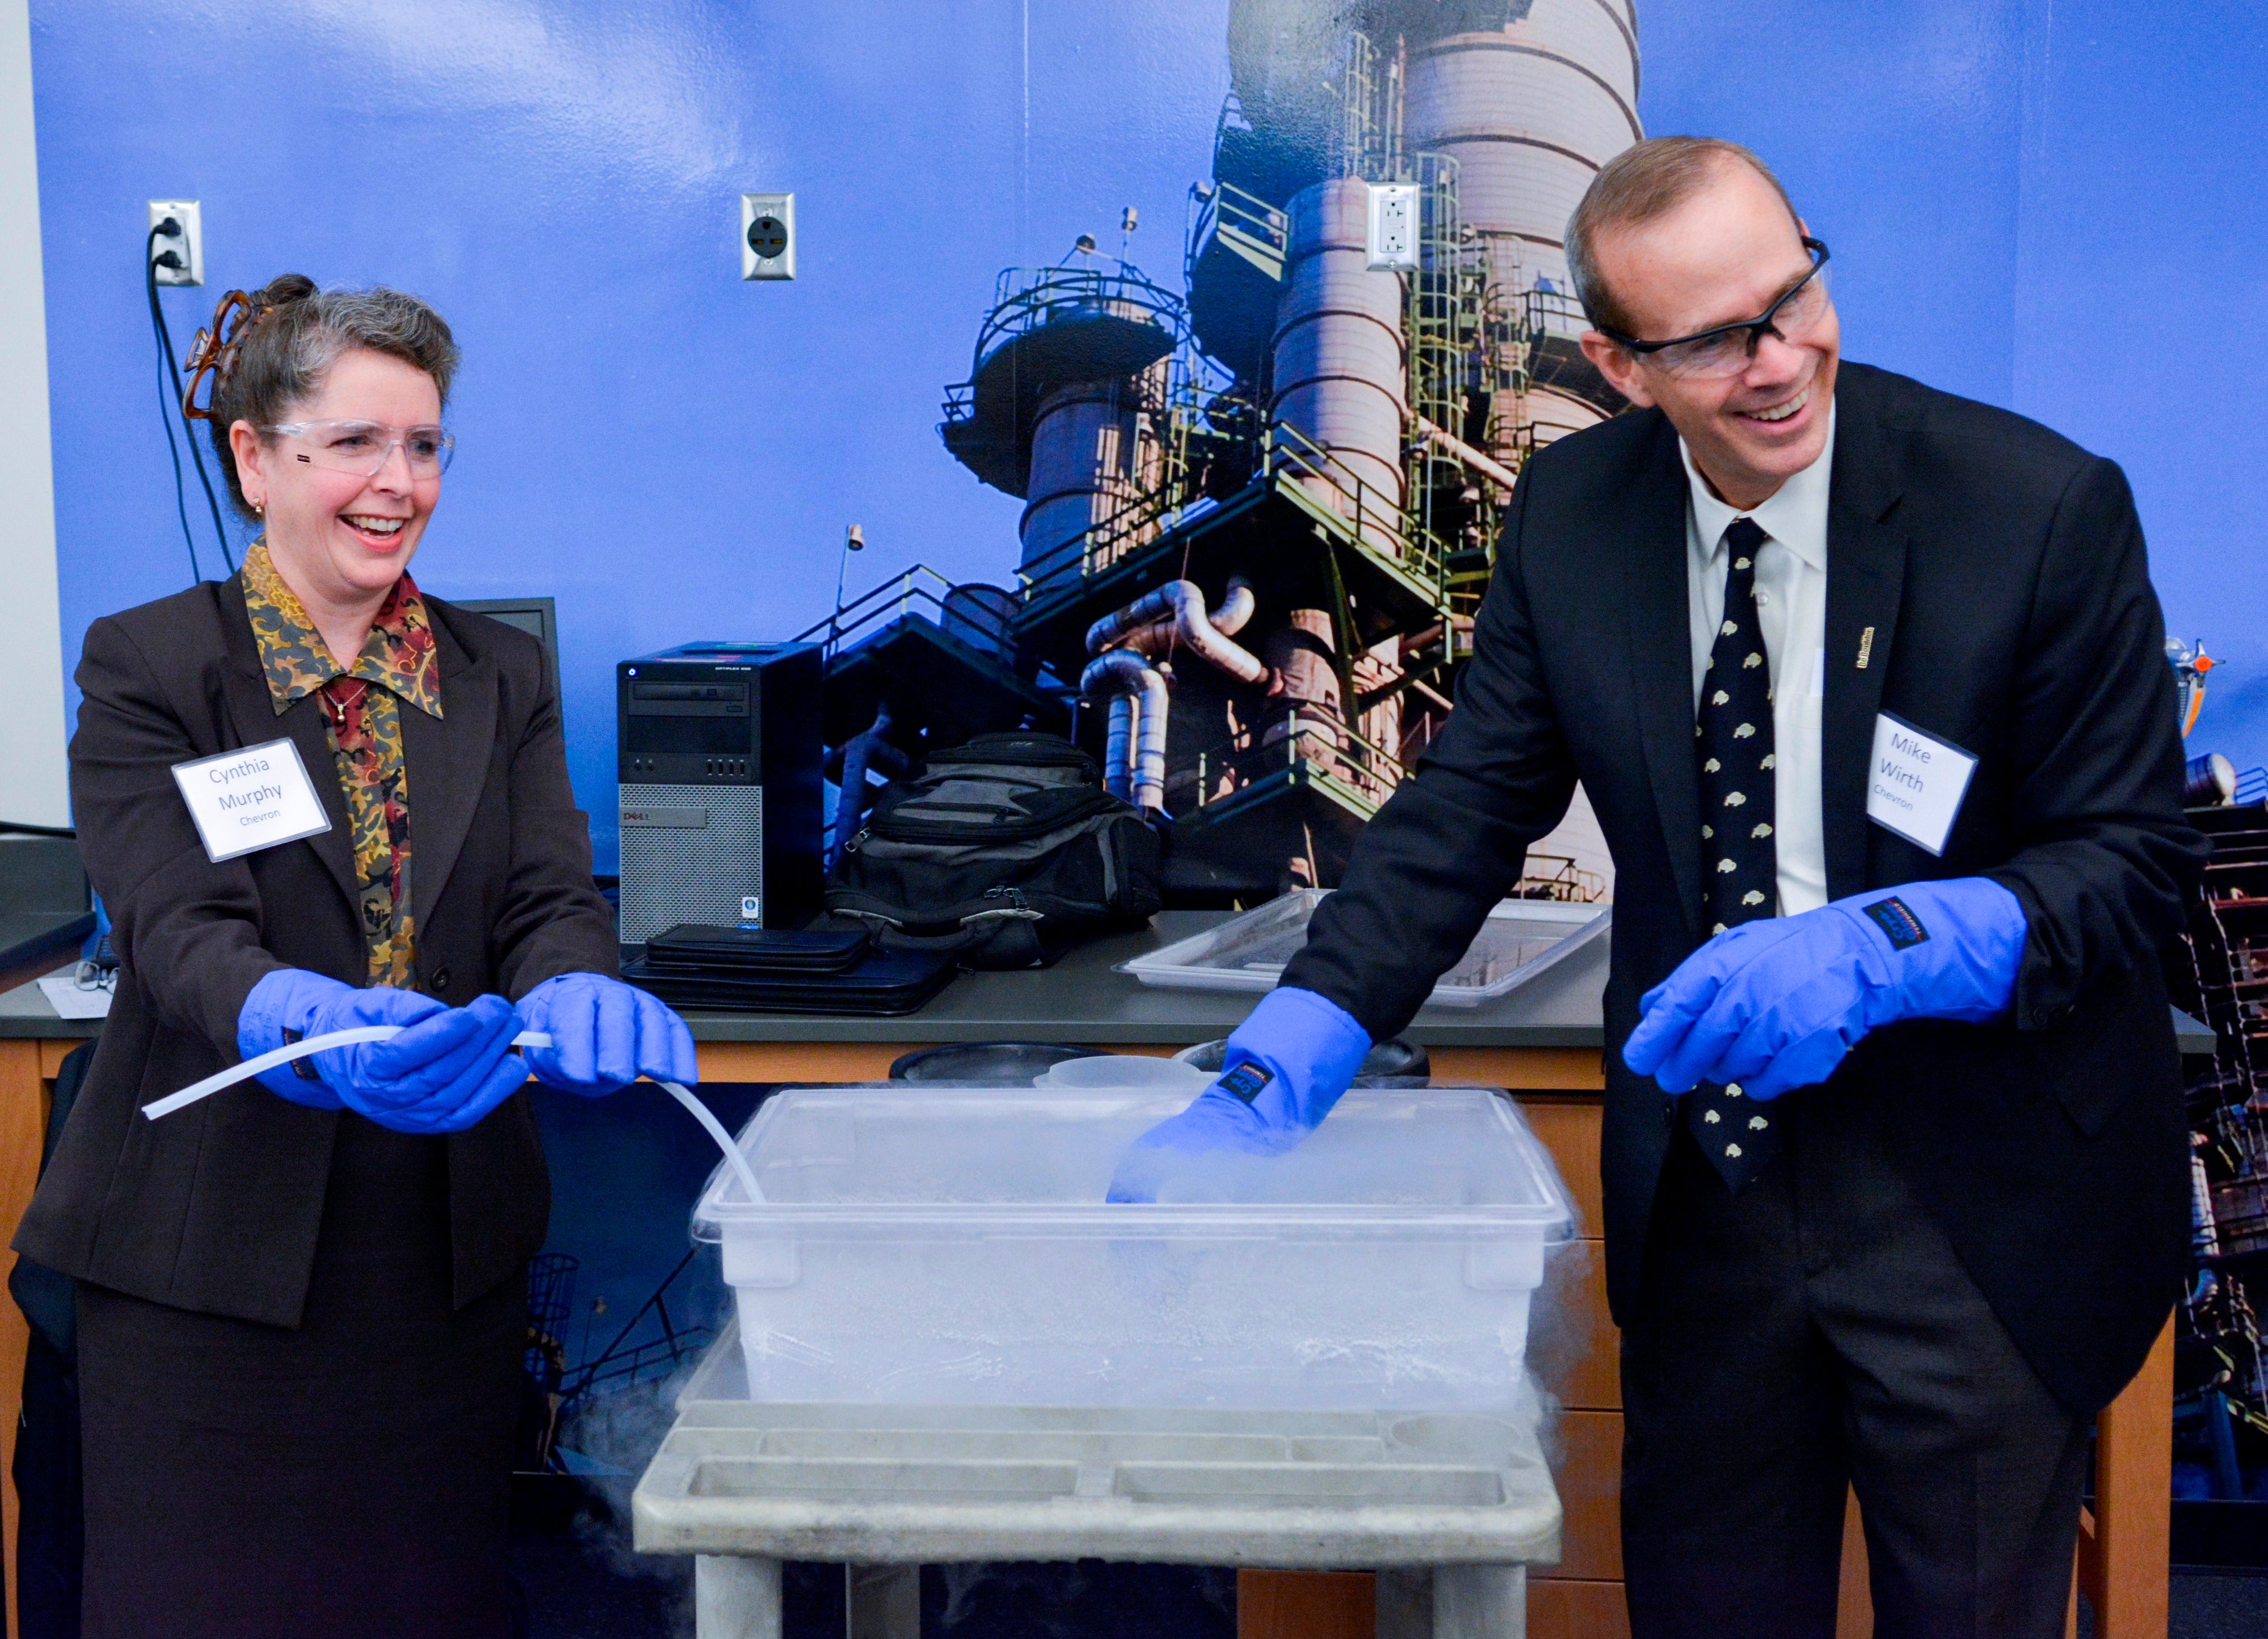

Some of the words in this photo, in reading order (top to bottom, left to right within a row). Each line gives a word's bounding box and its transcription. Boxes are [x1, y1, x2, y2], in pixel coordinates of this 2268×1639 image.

[1891, 733, 1931, 764] Mike
[209, 758, 270, 784] Cynthia
[1881, 758, 1924, 792] Wirth
[218, 785, 281, 810] Murphy
[1874, 784, 1913, 811] Chevron
[240, 809, 280, 825] Chevron
